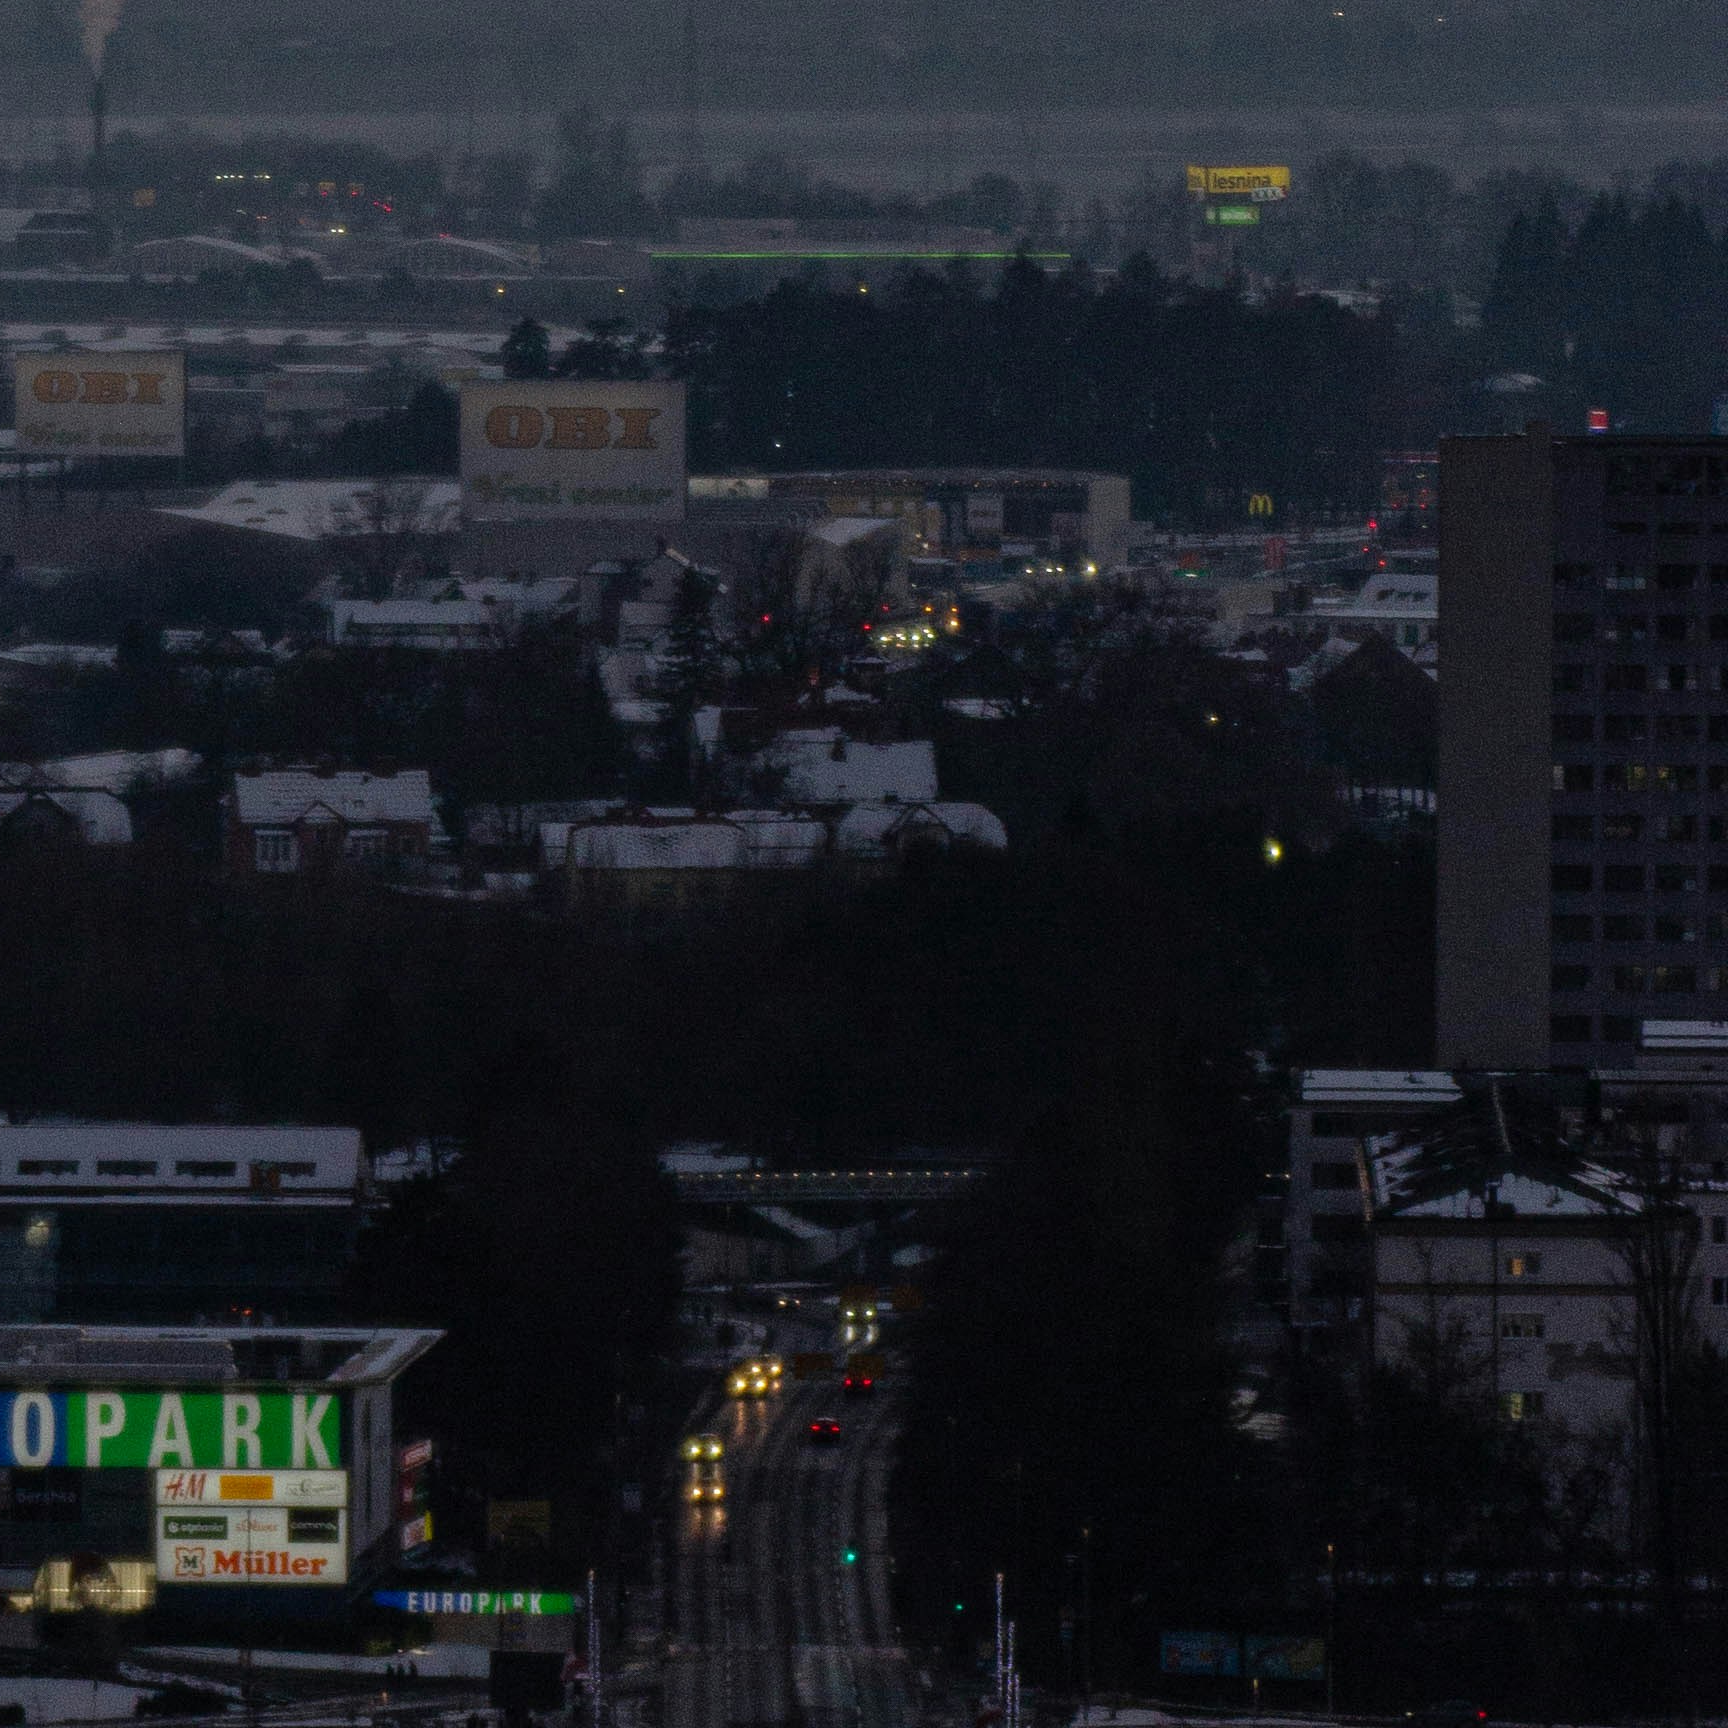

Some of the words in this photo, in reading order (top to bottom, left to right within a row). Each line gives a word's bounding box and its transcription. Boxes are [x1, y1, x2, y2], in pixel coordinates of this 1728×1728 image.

[1213, 173, 1271, 189] lesnina
[32, 370, 165, 404] OBI
[485, 406, 660, 449] OBI
[213, 1549, 327, 1575] Müller
[407, 1591, 543, 1615] EUROPARK
